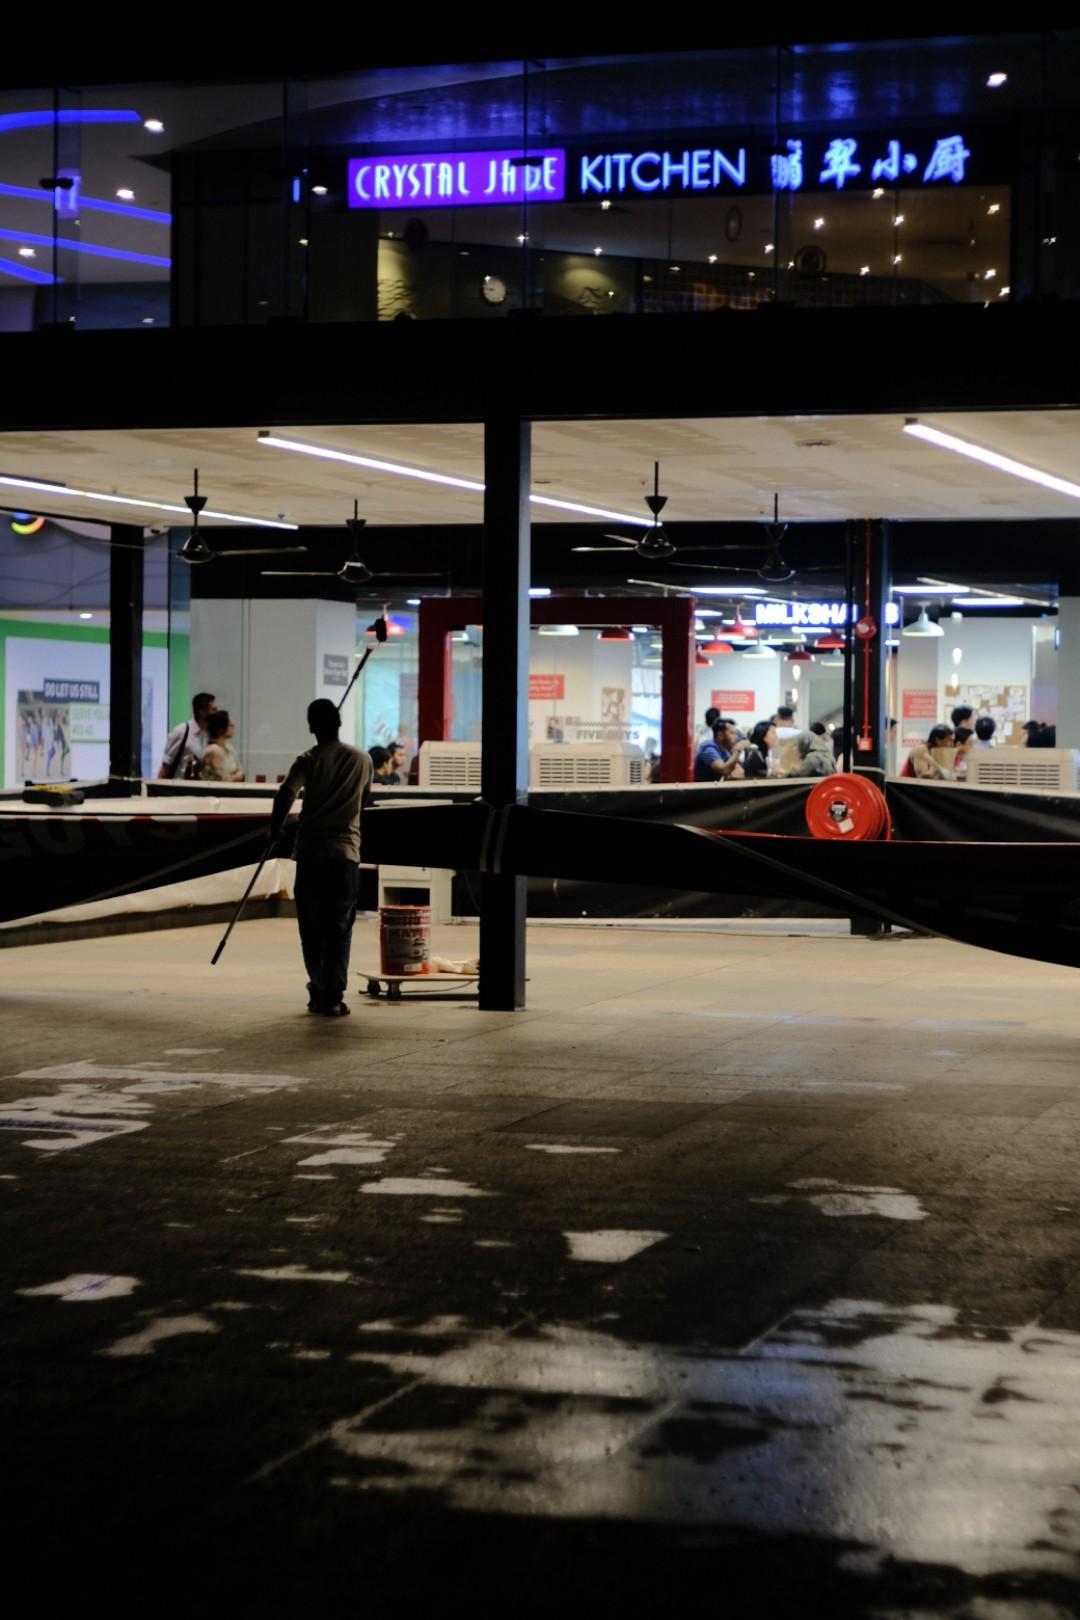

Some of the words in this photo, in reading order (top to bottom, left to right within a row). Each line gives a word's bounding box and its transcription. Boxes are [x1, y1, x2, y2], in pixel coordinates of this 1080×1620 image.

[354, 162, 470, 200] CRYSTAL
[484, 156, 558, 195] JADE
[580, 148, 747, 193] KITCHEN
